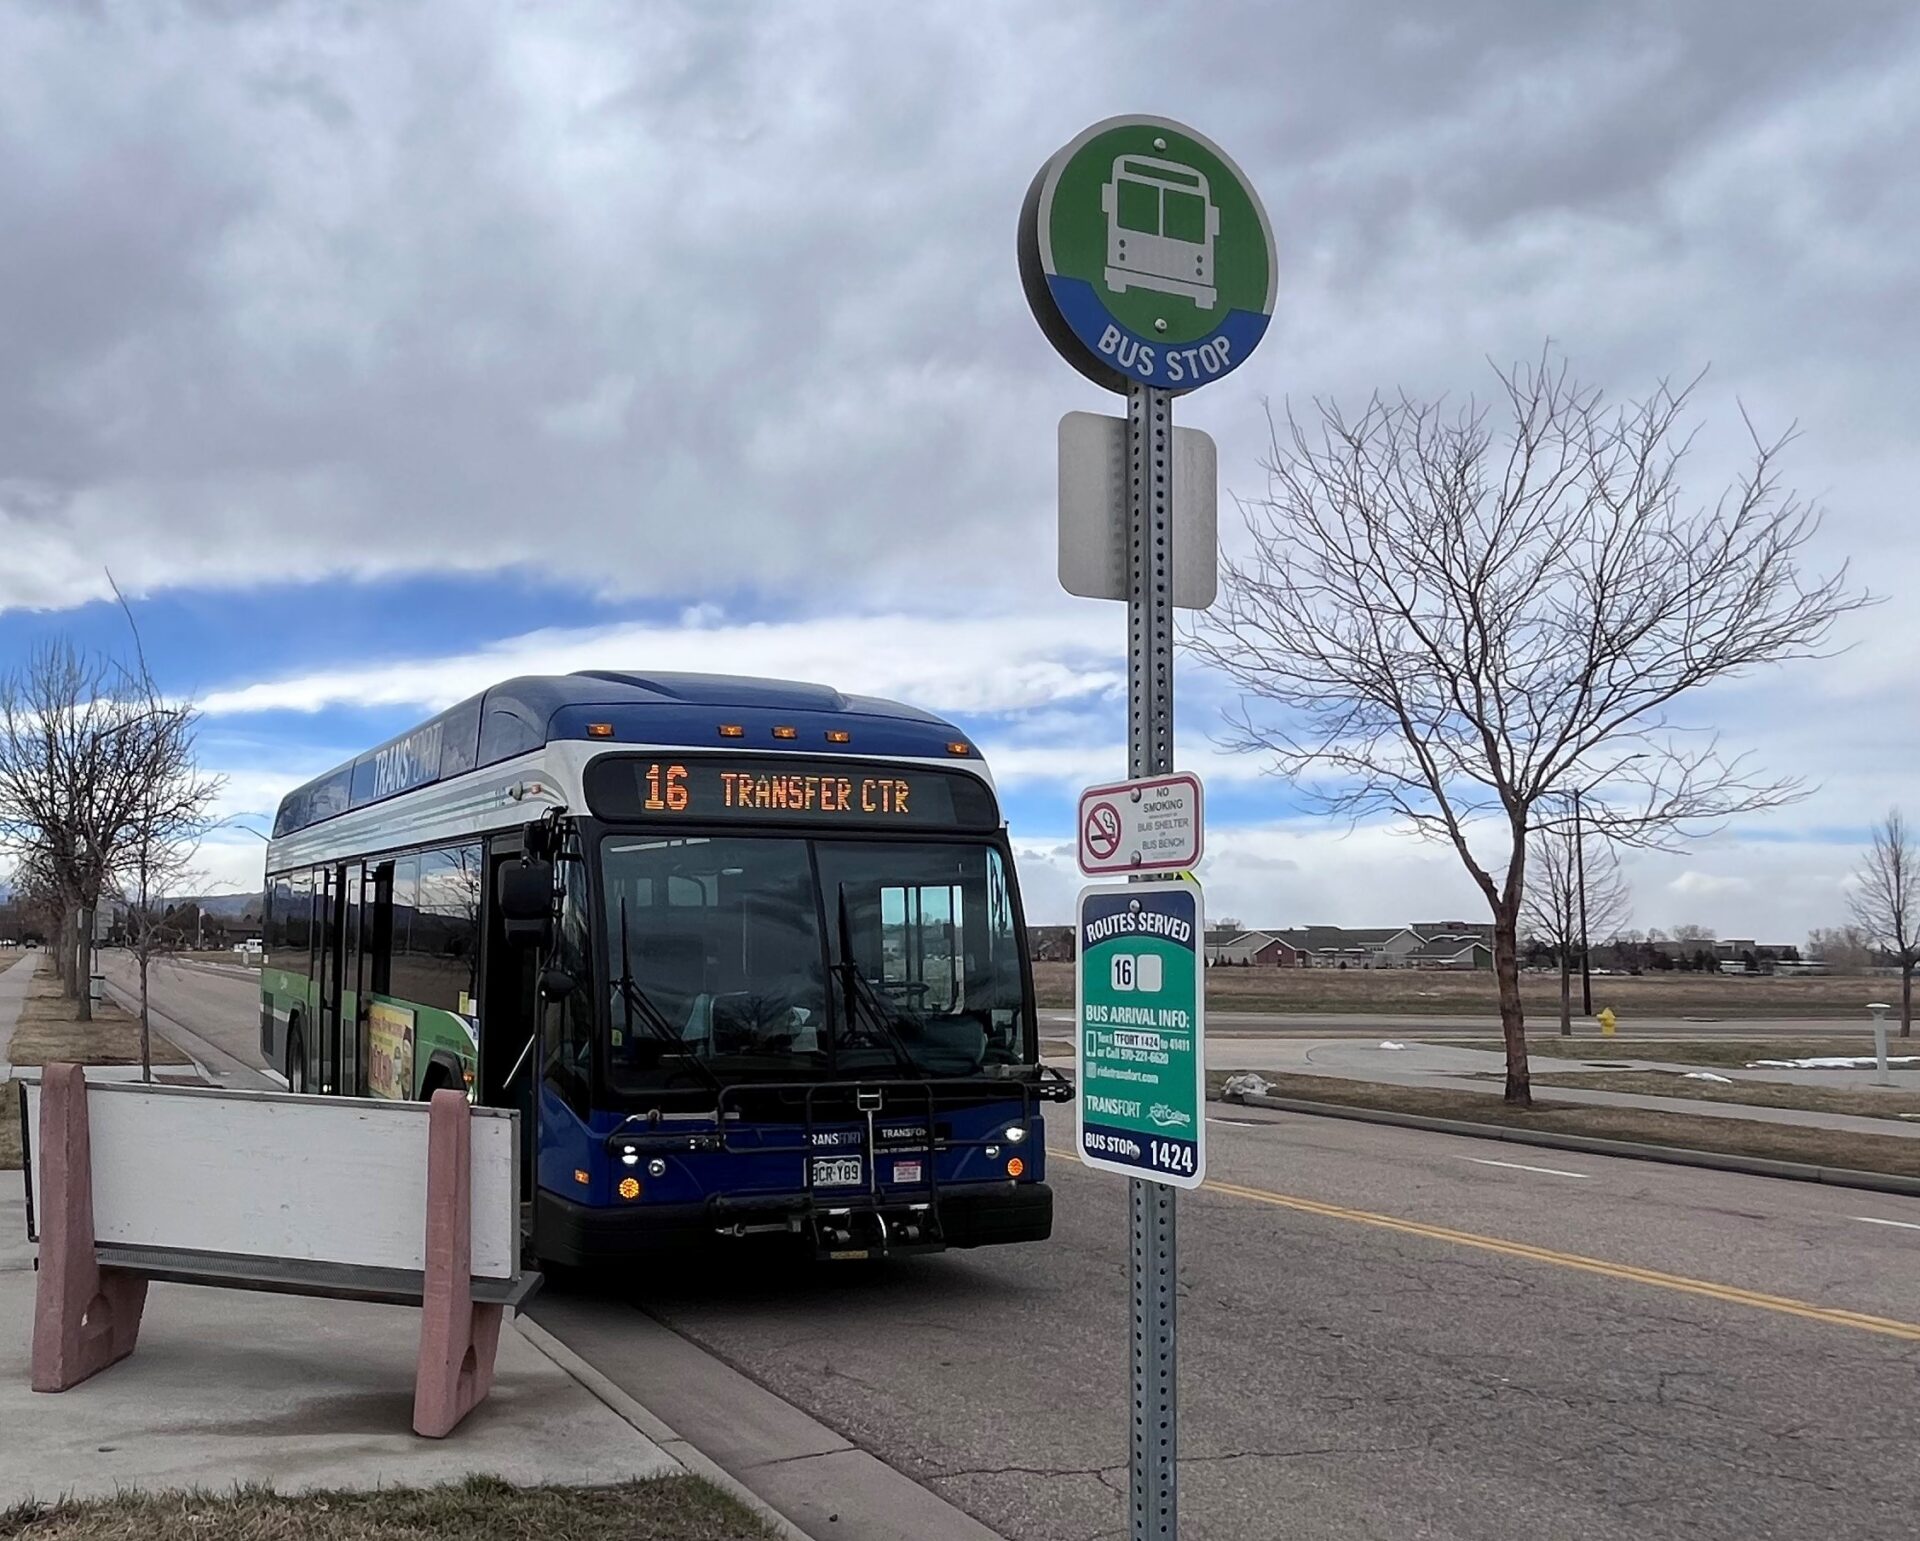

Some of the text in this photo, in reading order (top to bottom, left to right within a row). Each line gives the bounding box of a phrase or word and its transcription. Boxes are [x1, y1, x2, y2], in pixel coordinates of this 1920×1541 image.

[1097, 323, 1230, 381] BUS STOP
[373, 722, 442, 798] TRANSFORT
[645, 764, 909, 813] 16 TRANSFER CTR
[1156, 787, 1169, 798] NO
[1143, 799, 1183, 813] SMOKING
[1137, 818, 1189, 832] BUS SHELTER
[1142, 838, 1185, 850] BUS BENCH
[1086, 912, 1191, 943] ROUTES SERVED
[1114, 959, 1132, 985] 16
[1085, 1005, 1190, 1028] BUS ARRIVAL INFO:
[1097, 1032, 1113, 1044] Text
[1115, 1034, 1139, 1045] TFORT
[1140, 1036, 1159, 1048] 1424
[1161, 1039, 1169, 1050] to
[1097, 1049, 1105, 1057] or
[1106, 1047, 1120, 1060] Call
[1085, 1095, 1141, 1118] TRANSFORT
[803, 1132, 861, 1145] RANSFORT
[1085, 1132, 1193, 1173] BUS STOP 1424
